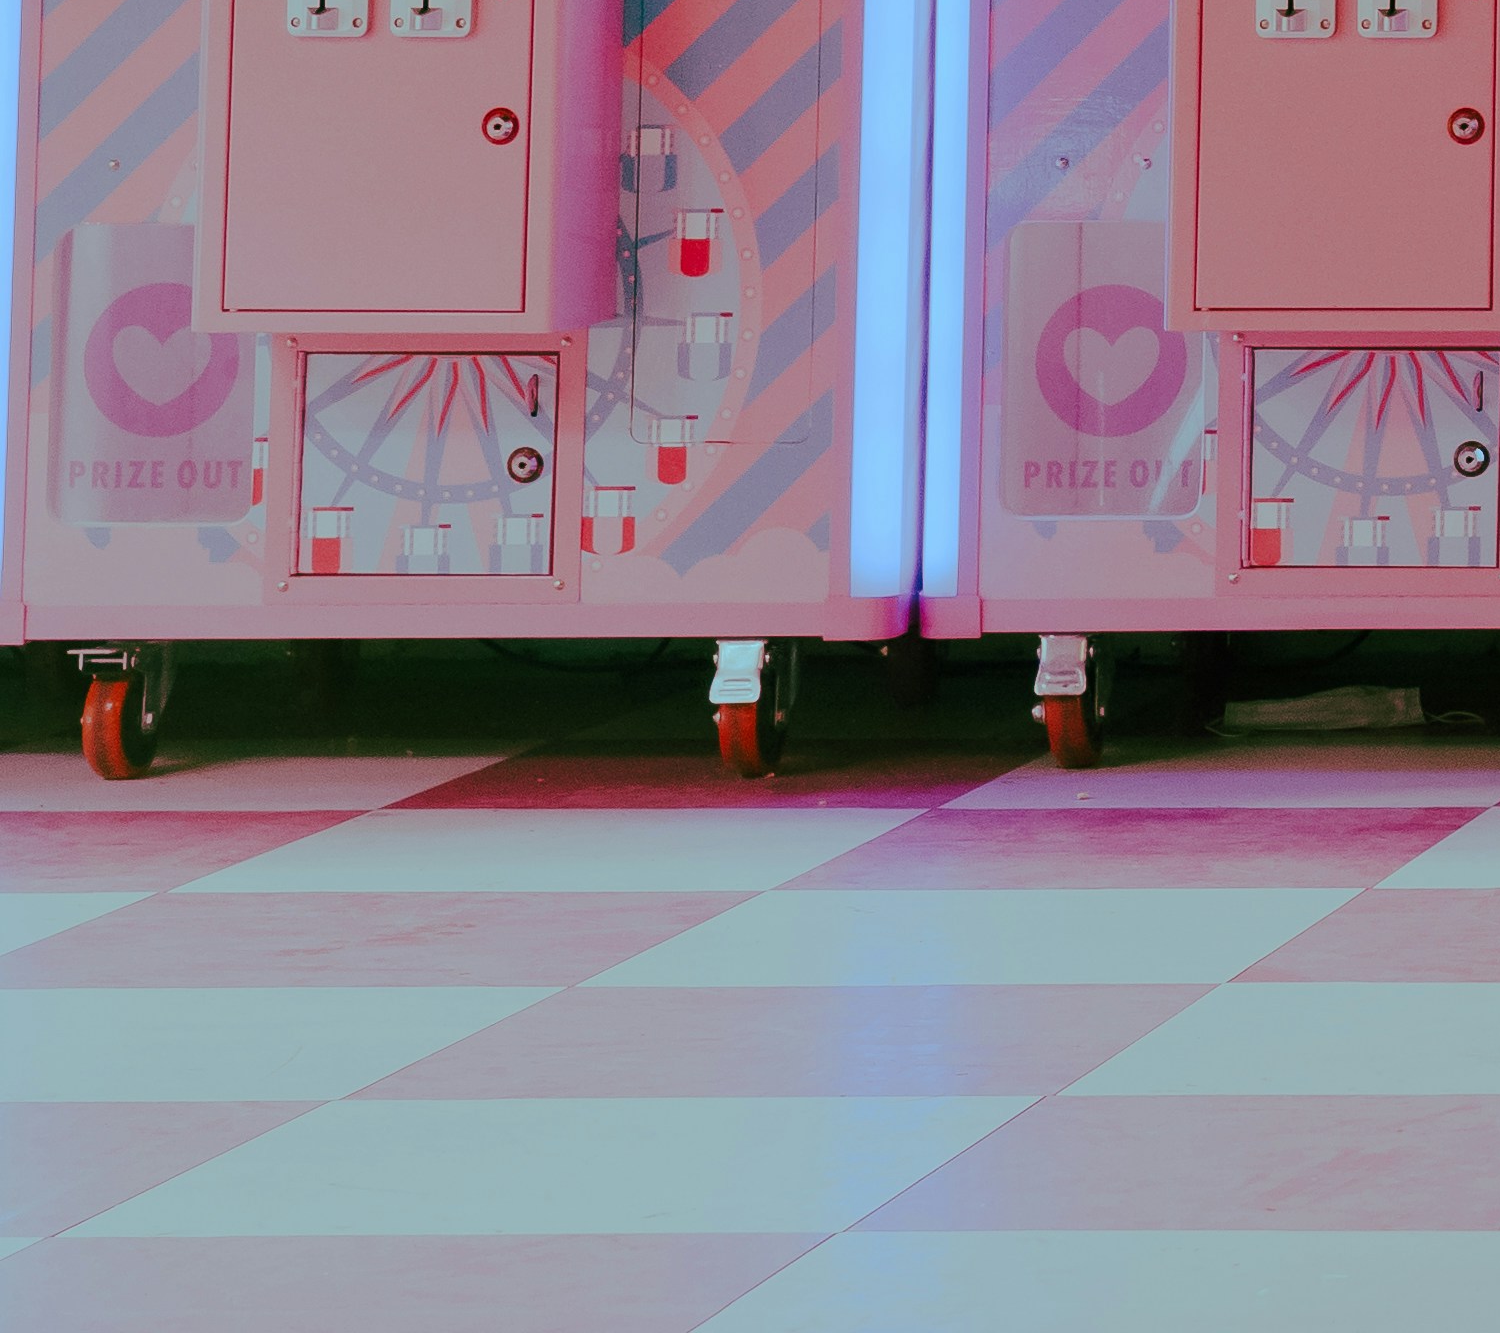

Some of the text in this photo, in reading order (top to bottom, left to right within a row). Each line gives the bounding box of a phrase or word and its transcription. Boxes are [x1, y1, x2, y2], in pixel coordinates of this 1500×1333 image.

[68, 459, 243, 489] PRIZE OUT
[1023, 460, 1118, 489] PRIZE
